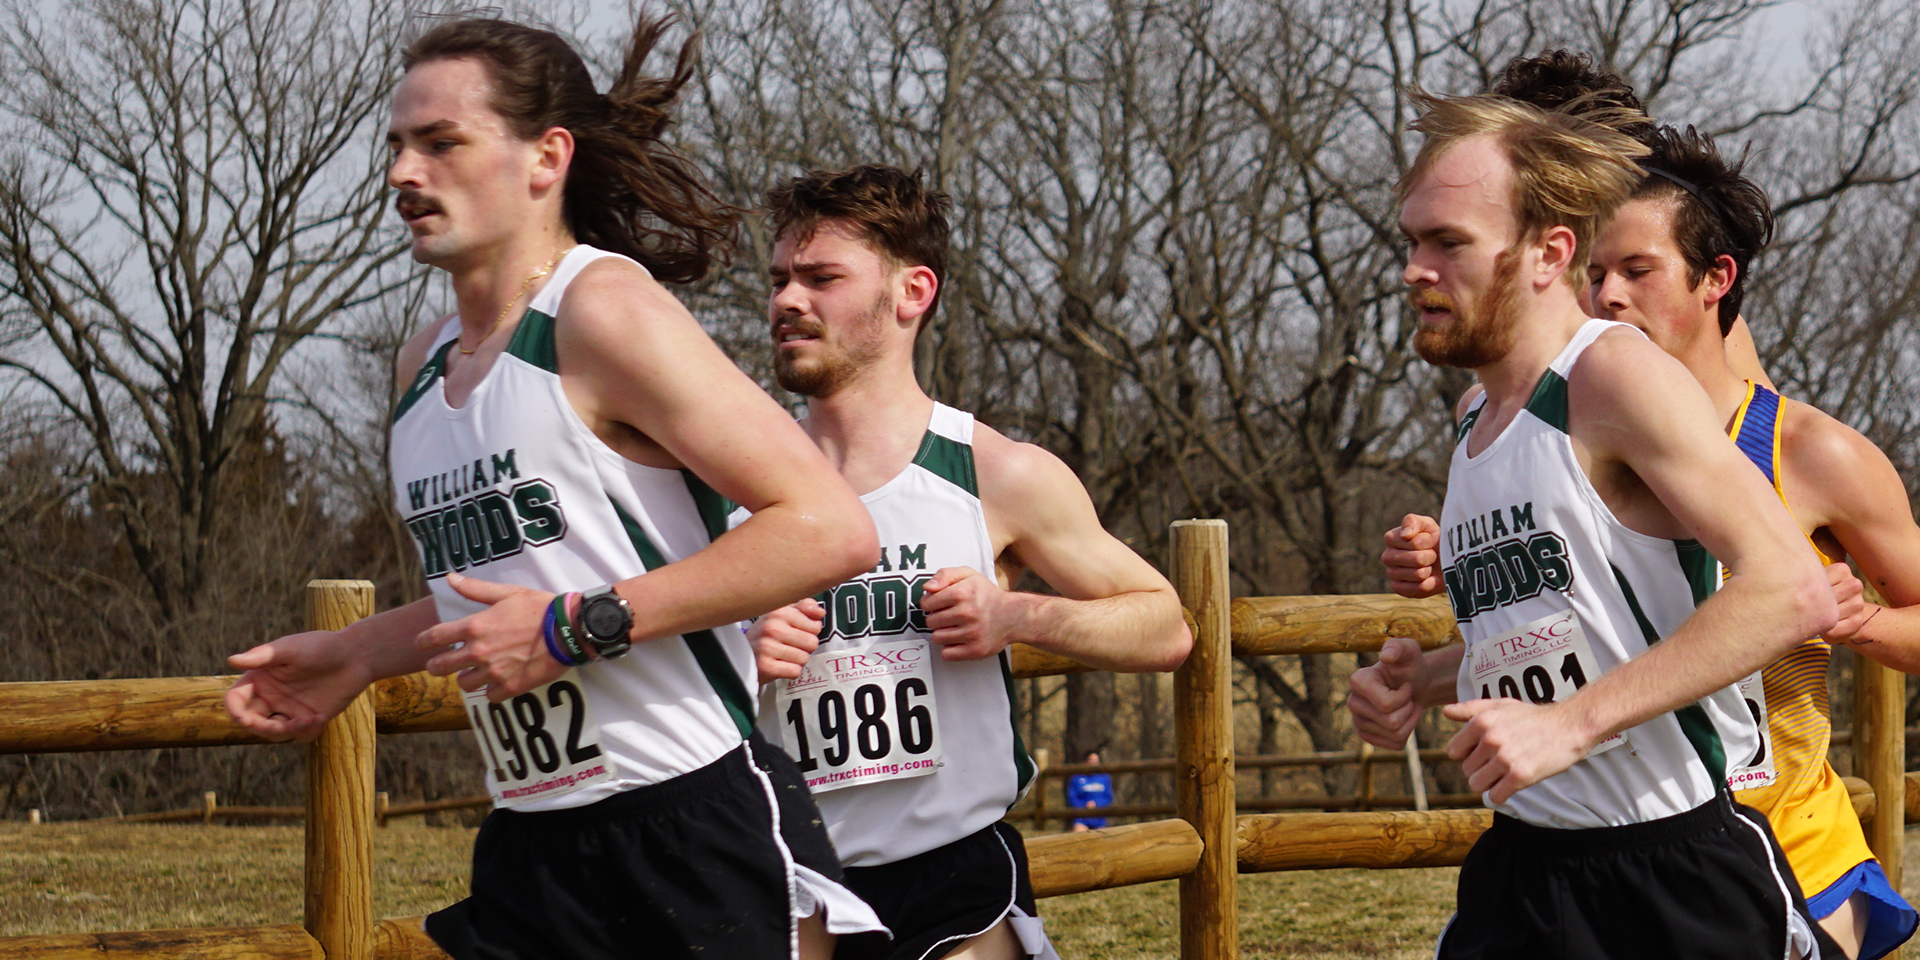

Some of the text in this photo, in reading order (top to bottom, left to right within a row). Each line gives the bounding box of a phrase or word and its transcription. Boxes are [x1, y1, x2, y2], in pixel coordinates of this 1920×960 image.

[407, 448, 521, 511] WILLIAM
[404, 477, 569, 580] WOODS
[1442, 530, 1575, 623] WOODS
[826, 647, 921, 673] TRXC
[1494, 618, 1573, 657] TRXC
[1549, 636, 1573, 648] LLC
[893, 662, 918, 671] LLC
[472, 680, 603, 783] 1982
[786, 677, 933, 773] 1986
[805, 758, 934, 787] ww.trxctiming.com
